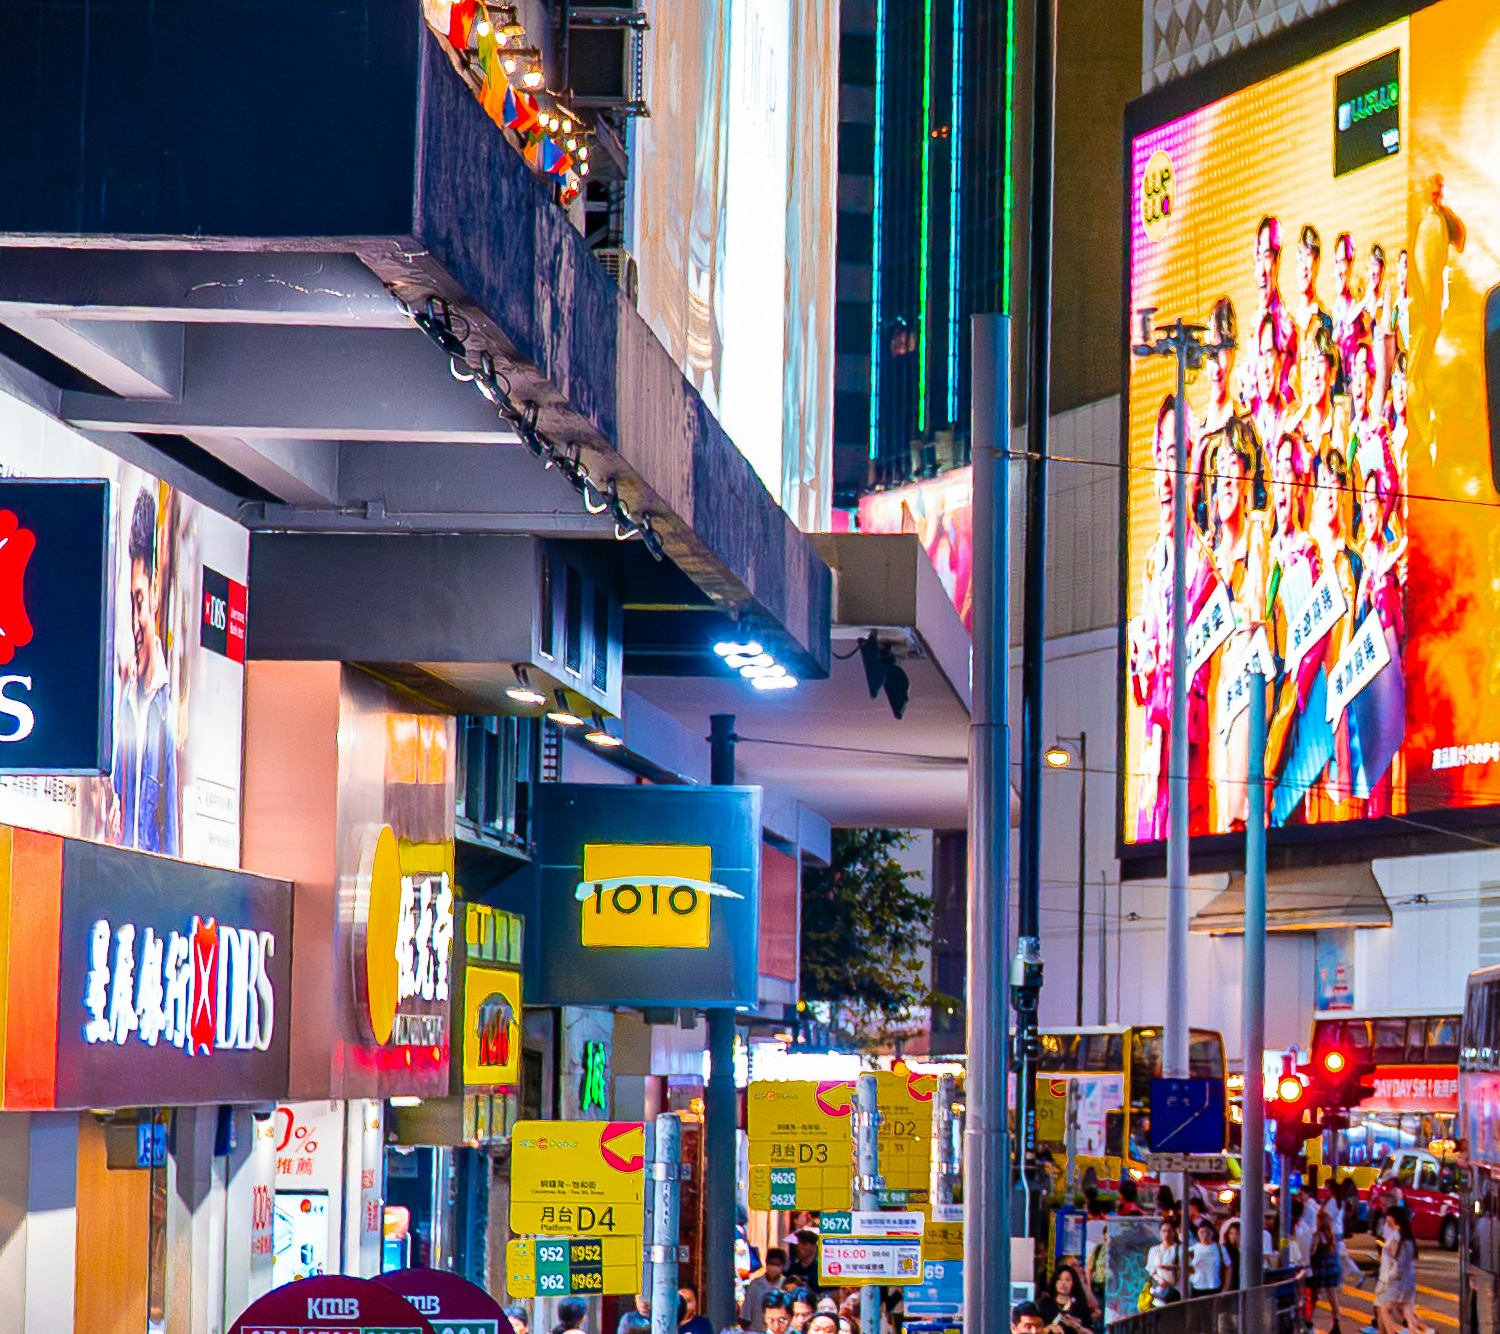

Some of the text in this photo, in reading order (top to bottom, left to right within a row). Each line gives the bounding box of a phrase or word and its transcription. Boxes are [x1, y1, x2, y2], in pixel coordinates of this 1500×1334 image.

[210, 596, 226, 630] DBS
[216, 925, 275, 1051] DBS
[893, 1121, 916, 1136] D2
[771, 1144, 828, 1163] 月台 D3
[771, 1173, 795, 1184] 962G
[771, 1194, 796, 1206] 962X
[541, 1207, 616, 1231] 月台 D4
[822, 1218, 850, 1230] 967X
[540, 1247, 564, 1262] 952
[837, 1249, 866, 1259] 16:00
[540, 1274, 564, 1290] 962
[307, 1297, 360, 1319] KMB
